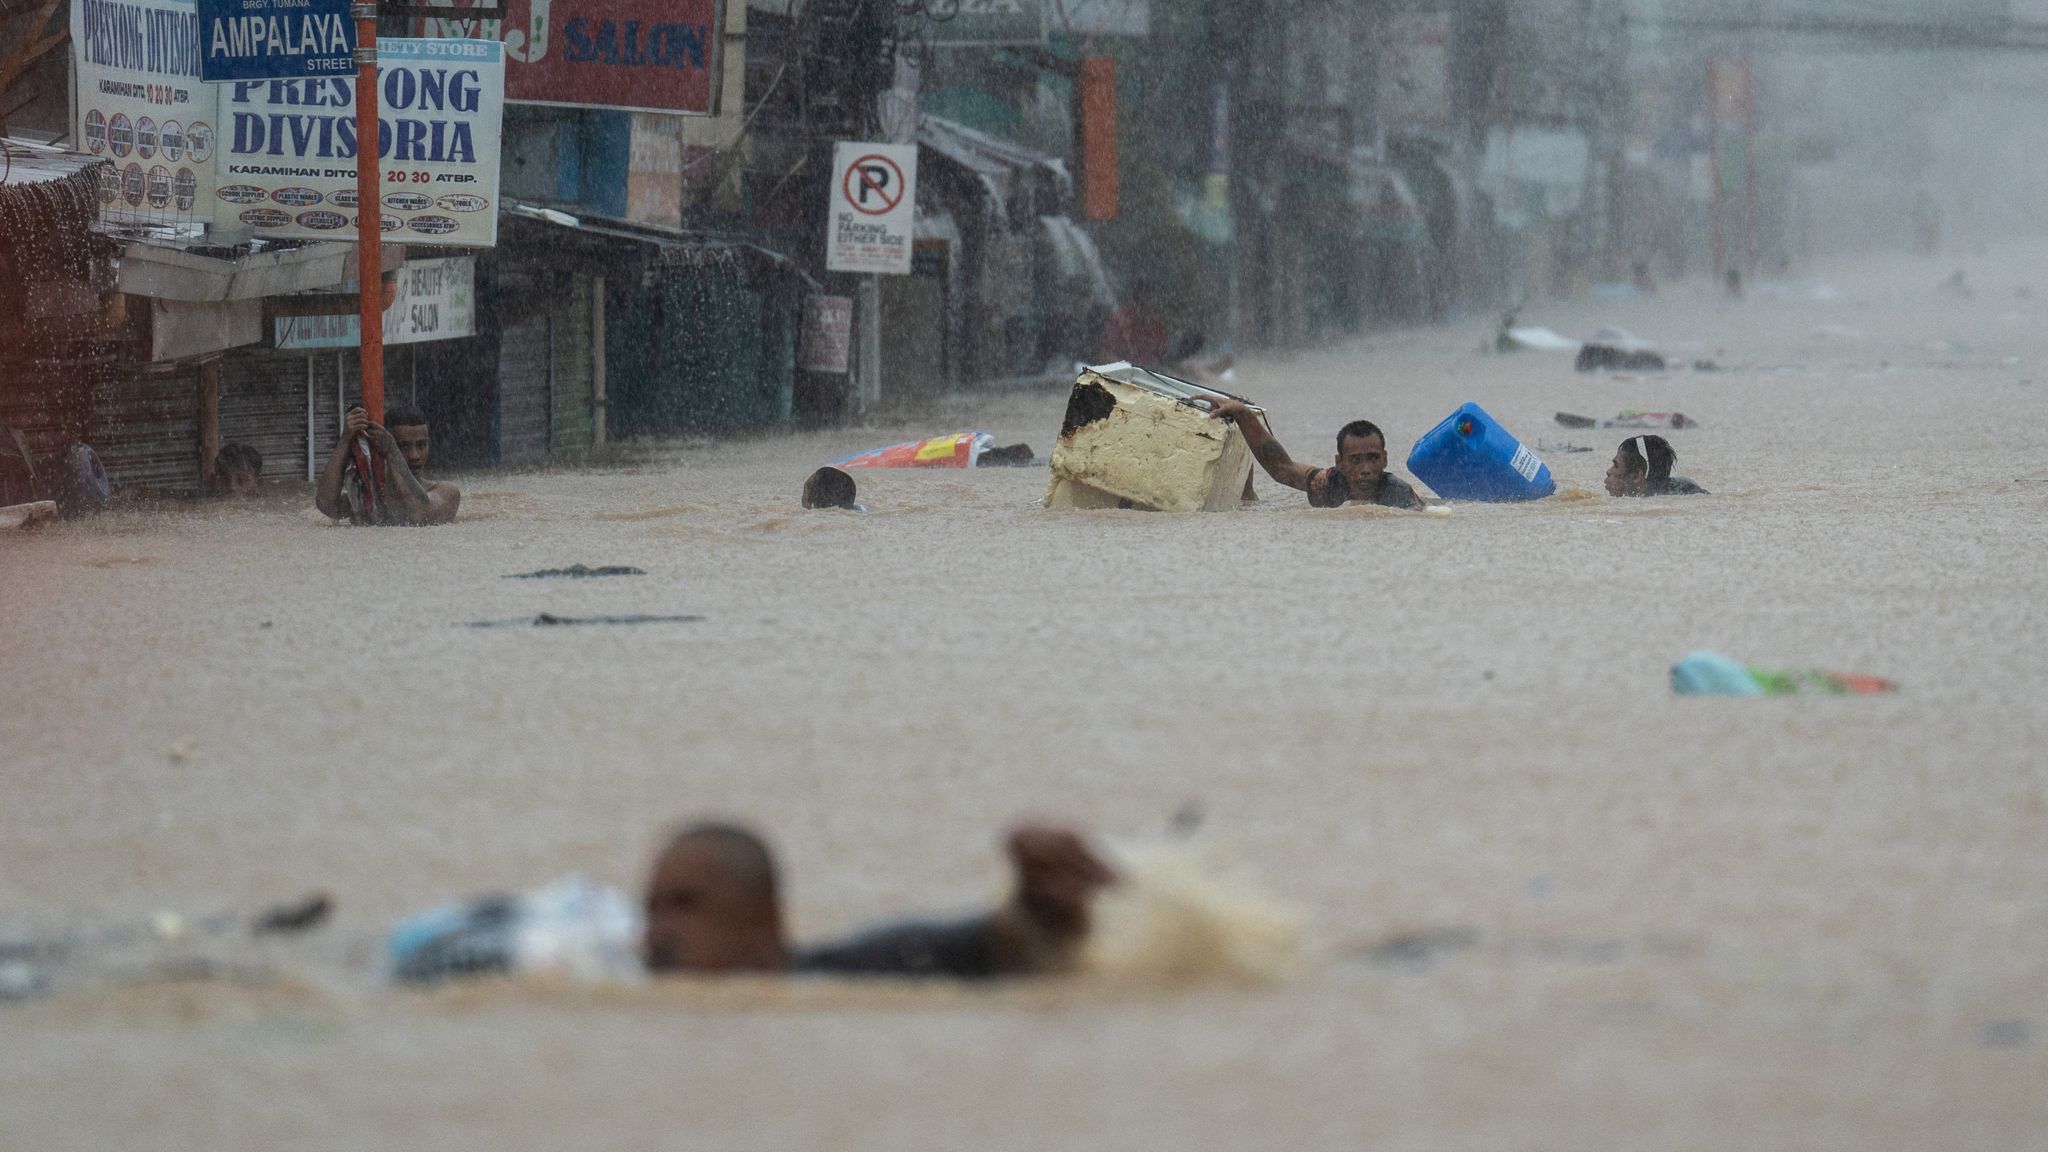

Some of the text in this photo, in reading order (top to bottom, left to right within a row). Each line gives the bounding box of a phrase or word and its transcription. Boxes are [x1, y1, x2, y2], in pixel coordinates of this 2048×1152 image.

[83, 0, 200, 77] PRESYONG DIVISOR
[211, 14, 349, 58] AMPALAYA
[563, 18, 706, 71] SALON
[426, 43, 488, 57] STORE
[307, 58, 353, 71] STREET
[99, 80, 132, 97] KARAMIHAN
[147, 84, 153, 103] 10
[155, 84, 163, 104] 20
[165, 85, 172, 105] 30
[231, 66, 482, 113] PRESONG
[229, 165, 320, 177] KARAMIHAN
[325, 169, 357, 179] DITO
[388, 171, 406, 182] 20
[412, 172, 430, 183] 30
[436, 174, 478, 183] ATBP.
[838, 212, 854, 221] NO
[838, 222, 887, 233] PARKING
[411, 267, 443, 296] BEAUTY
[411, 303, 439, 333] SALON
